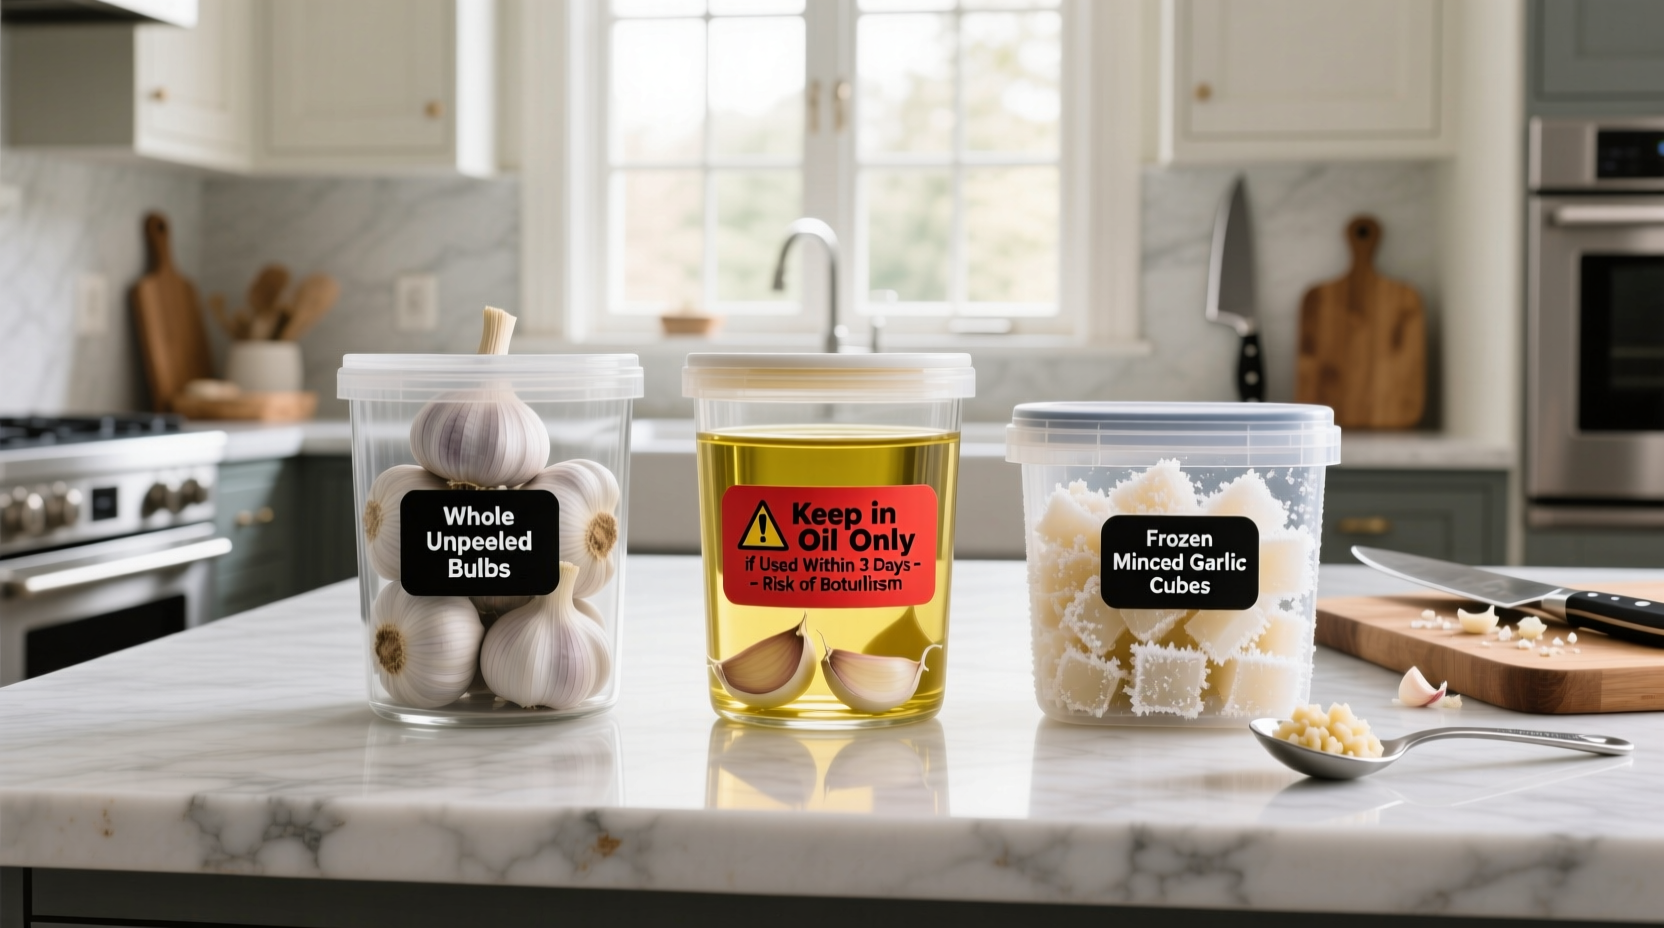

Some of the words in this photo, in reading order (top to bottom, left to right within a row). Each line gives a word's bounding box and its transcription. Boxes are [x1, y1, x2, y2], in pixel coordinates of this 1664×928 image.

[443, 505, 515, 526] Whole
[792, 501, 863, 531] Keep
[871, 500, 896, 525] in
[426, 530, 532, 556] Unpeeled
[798, 528, 838, 552] Oil
[849, 527, 916, 556] Only
[1146, 529, 1213, 547] Frozen
[448, 557, 511, 579] Bulbs
[745, 555, 756, 571] if
[759, 556, 798, 572] Used
[803, 557, 855, 573] Within
[859, 558, 869, 572] 3
[873, 558, 911, 575] Days
[1113, 552, 1184, 571] Minced
[1190, 552, 1247, 571] Garlic
[763, 576, 795, 591] Risk
[799, 576, 817, 591] of
[1149, 575, 1211, 595] Cubes
